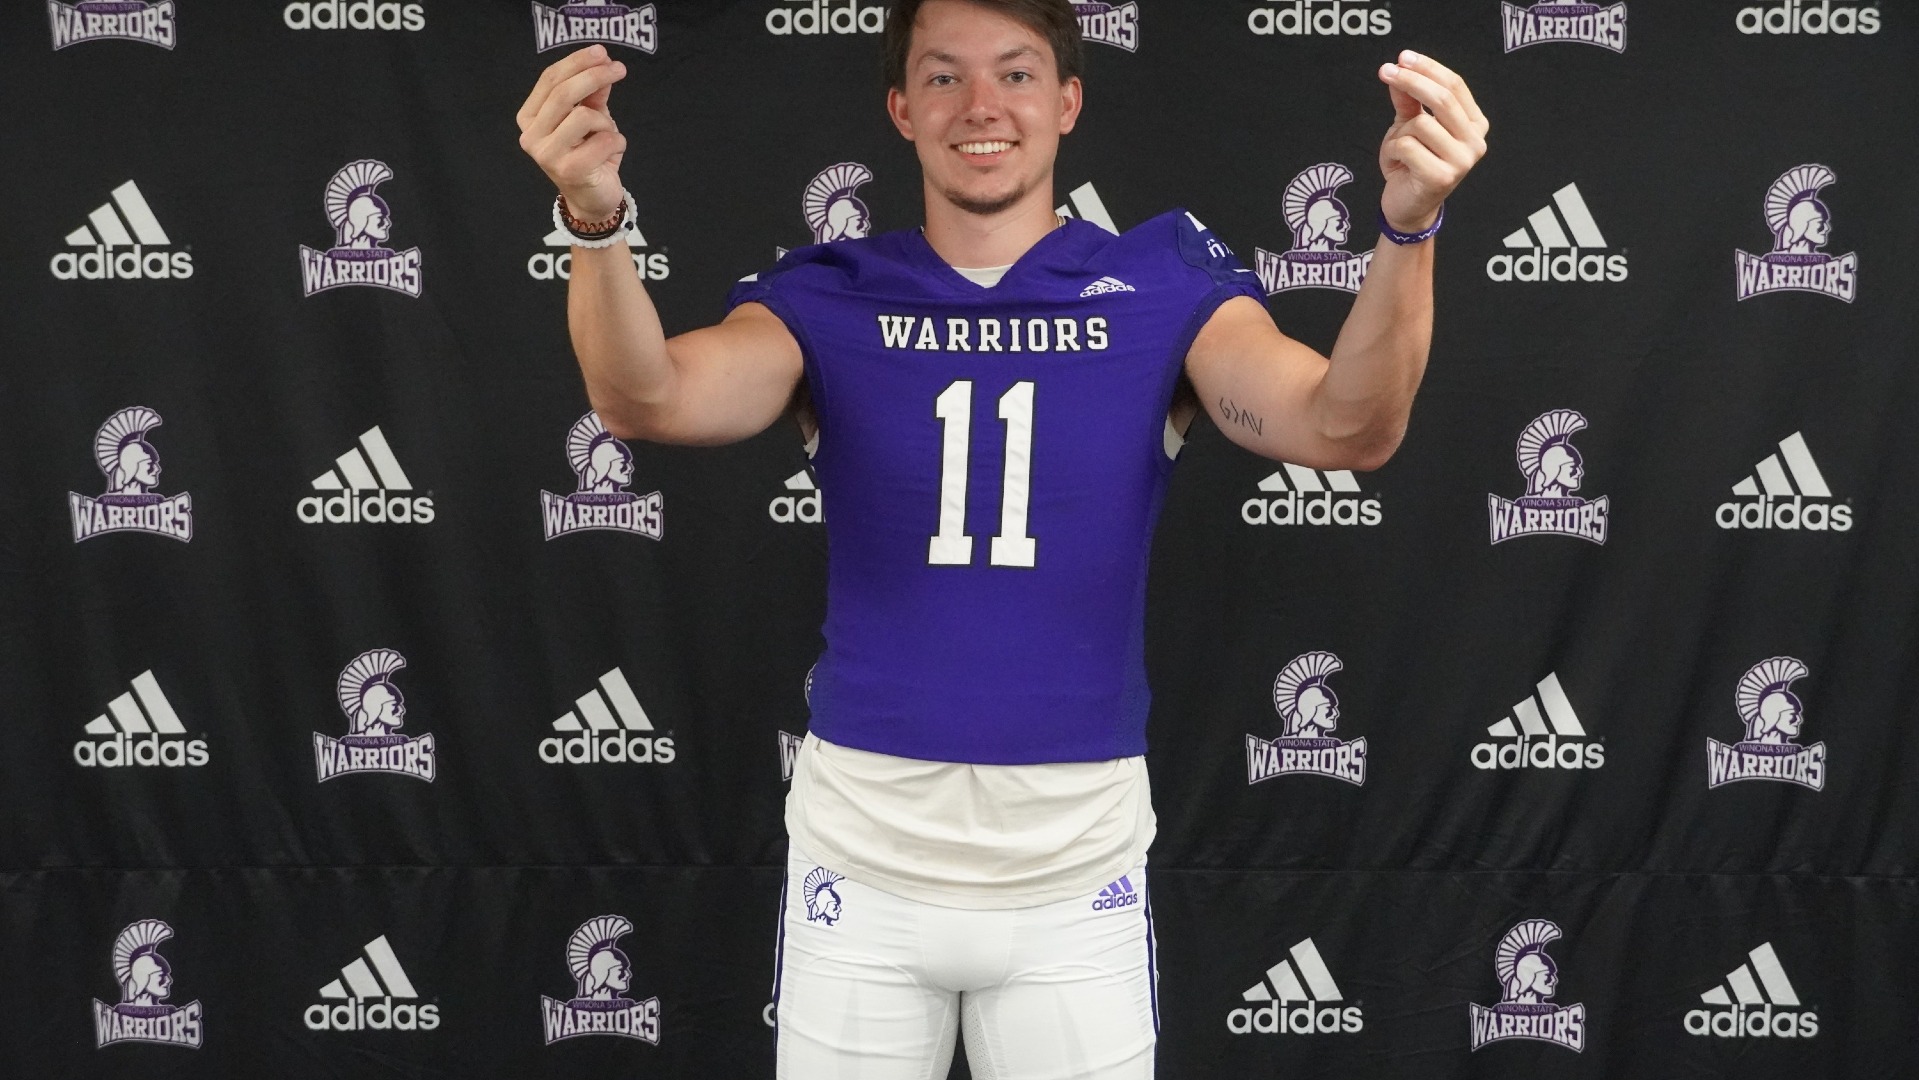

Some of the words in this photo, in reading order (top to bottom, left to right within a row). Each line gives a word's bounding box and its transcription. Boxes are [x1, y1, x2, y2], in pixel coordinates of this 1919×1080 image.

[51, 1, 174, 48] WARRIORS
[284, 0, 426, 31] adidas
[535, 3, 654, 52] WARRIORS
[565, 7, 597, 15] WINONA
[598, 7, 624, 16] STATE
[765, 0, 889, 35] adida
[1077, 4, 1135, 50] IORS
[1082, 6, 1107, 14] STATE
[1247, 0, 1392, 35] adidas
[1504, 3, 1624, 51] WARRIORS
[1570, 7, 1595, 15] STATE
[1735, 0, 1881, 35] adidas
[51, 244, 194, 280] adidas
[303, 247, 420, 295] WARRIORS
[1486, 246, 1628, 282] adidas
[1737, 251, 1855, 300] WARRIORS
[1768, 255, 1801, 263] WINONA
[1802, 255, 1826, 263] STATE
[1080, 284, 1135, 297] adidas
[877, 314, 1109, 352] WARRIORS
[927, 379, 1036, 568] 11
[72, 494, 191, 540] WARRIORS
[297, 488, 435, 524] adidas
[543, 494, 662, 540] WARRIORS
[574, 495, 607, 503] WINONA
[608, 495, 632, 503] STATE
[1241, 490, 1383, 526] adidas
[1521, 499, 1555, 507] WINONA
[1556, 499, 1580, 507] STATE
[1715, 494, 1853, 531] adidas
[1490, 496, 1607, 544] WARRIORS
[73, 732, 210, 767] adidas
[316, 734, 435, 781] WARRIORS
[346, 737, 378, 745] WINONA
[380, 737, 404, 745] STATE
[538, 728, 676, 764] adidas
[1278, 739, 1311, 747] WINONA
[1312, 739, 1336, 747] STATE
[1470, 734, 1605, 769] adidas
[1739, 744, 1773, 753] WINONA
[1774, 745, 1798, 754] STATE
[1248, 737, 1366, 784] WARRIORS
[1709, 740, 1824, 789] WARRIORS
[1092, 893, 1138, 911] adidas
[96, 1000, 202, 1048] WARRIORS
[303, 996, 440, 1031] adidas
[543, 998, 659, 1044] WARRIORS
[1226, 999, 1364, 1034] adidas
[1471, 1005, 1584, 1052] WARRIORS
[1683, 1003, 1819, 1038] adidas
